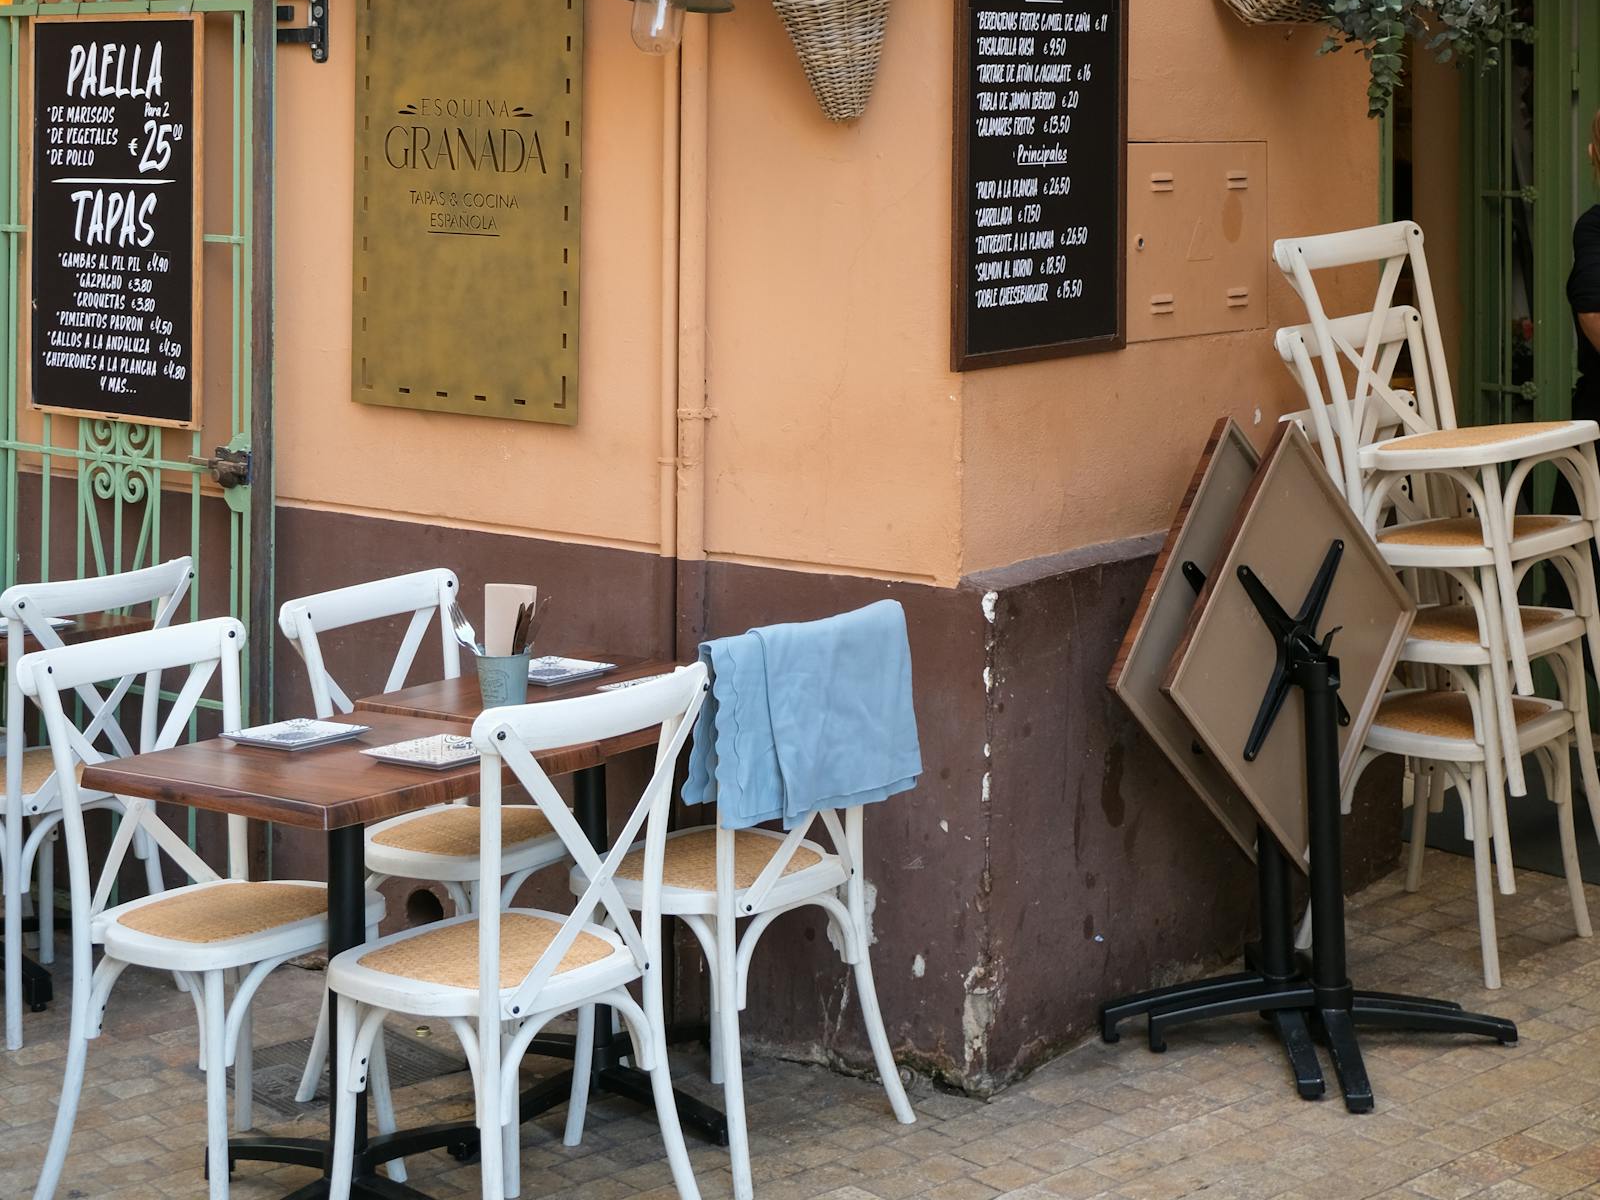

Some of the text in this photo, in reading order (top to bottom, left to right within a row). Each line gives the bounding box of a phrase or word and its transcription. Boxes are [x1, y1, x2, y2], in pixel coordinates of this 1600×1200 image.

[1019, 12, 1040, 31] FRITAS
[1065, 14, 1075, 31] DE
[1074, 12, 1090, 32] CAÑA
[1018, 37, 1034, 56] RUSA
[67, 41, 163, 99] PAELLA
[1006, 64, 1015, 82] DE
[144, 102, 169, 117] Para 2
[422, 99, 509, 118] ESQUINA
[999, 92, 1008, 110] DE
[51, 106, 115, 123] DE MARISCOS
[978, 117, 1012, 136] CALAMARES
[1013, 117, 1035, 135] FRITOS
[51, 128, 118, 145] DE VEGETALES
[50, 150, 95, 166] DE POLLO
[384, 126, 547, 174] GRANADA
[1017, 142, 1067, 167] Principales
[997, 180, 1002, 199] A
[1003, 179, 1011, 198] LA
[1013, 178, 1037, 197] PLANCHA
[409, 190, 519, 209] TAPAS & COCINA
[71, 188, 157, 248] TAPAS
[431, 211, 497, 230] ESPAÑOLA
[977, 234, 1012, 254] ENTRECOTE
[1013, 233, 1018, 251] A
[1020, 232, 1027, 251] LA
[1029, 230, 1054, 250] PLANCHA
[62, 252, 96, 269] GAMBAS
[99, 254, 109, 270] AL
[112, 255, 125, 270] PIL
[128, 256, 140, 272] PIL
[1003, 260, 1011, 279] AL
[1013, 258, 1033, 278] HORNO
[78, 273, 122, 289] GAZPACHO
[77, 292, 125, 310] CROQUETAS
[977, 288, 1000, 308] DOBLE
[58, 311, 107, 329] PIMIENTOS
[110, 315, 143, 331] PADRON
[51, 331, 82, 347] CALLOS
[84, 333, 90, 348] A
[93, 334, 102, 349] LA
[106, 335, 149, 354] ANDALUZA
[45, 351, 97, 370] CHIPIRONES
[99, 356, 104, 370] A
[107, 357, 117, 372] LA
[120, 358, 156, 376] PLANCHA
[100, 376, 107, 390] Y
